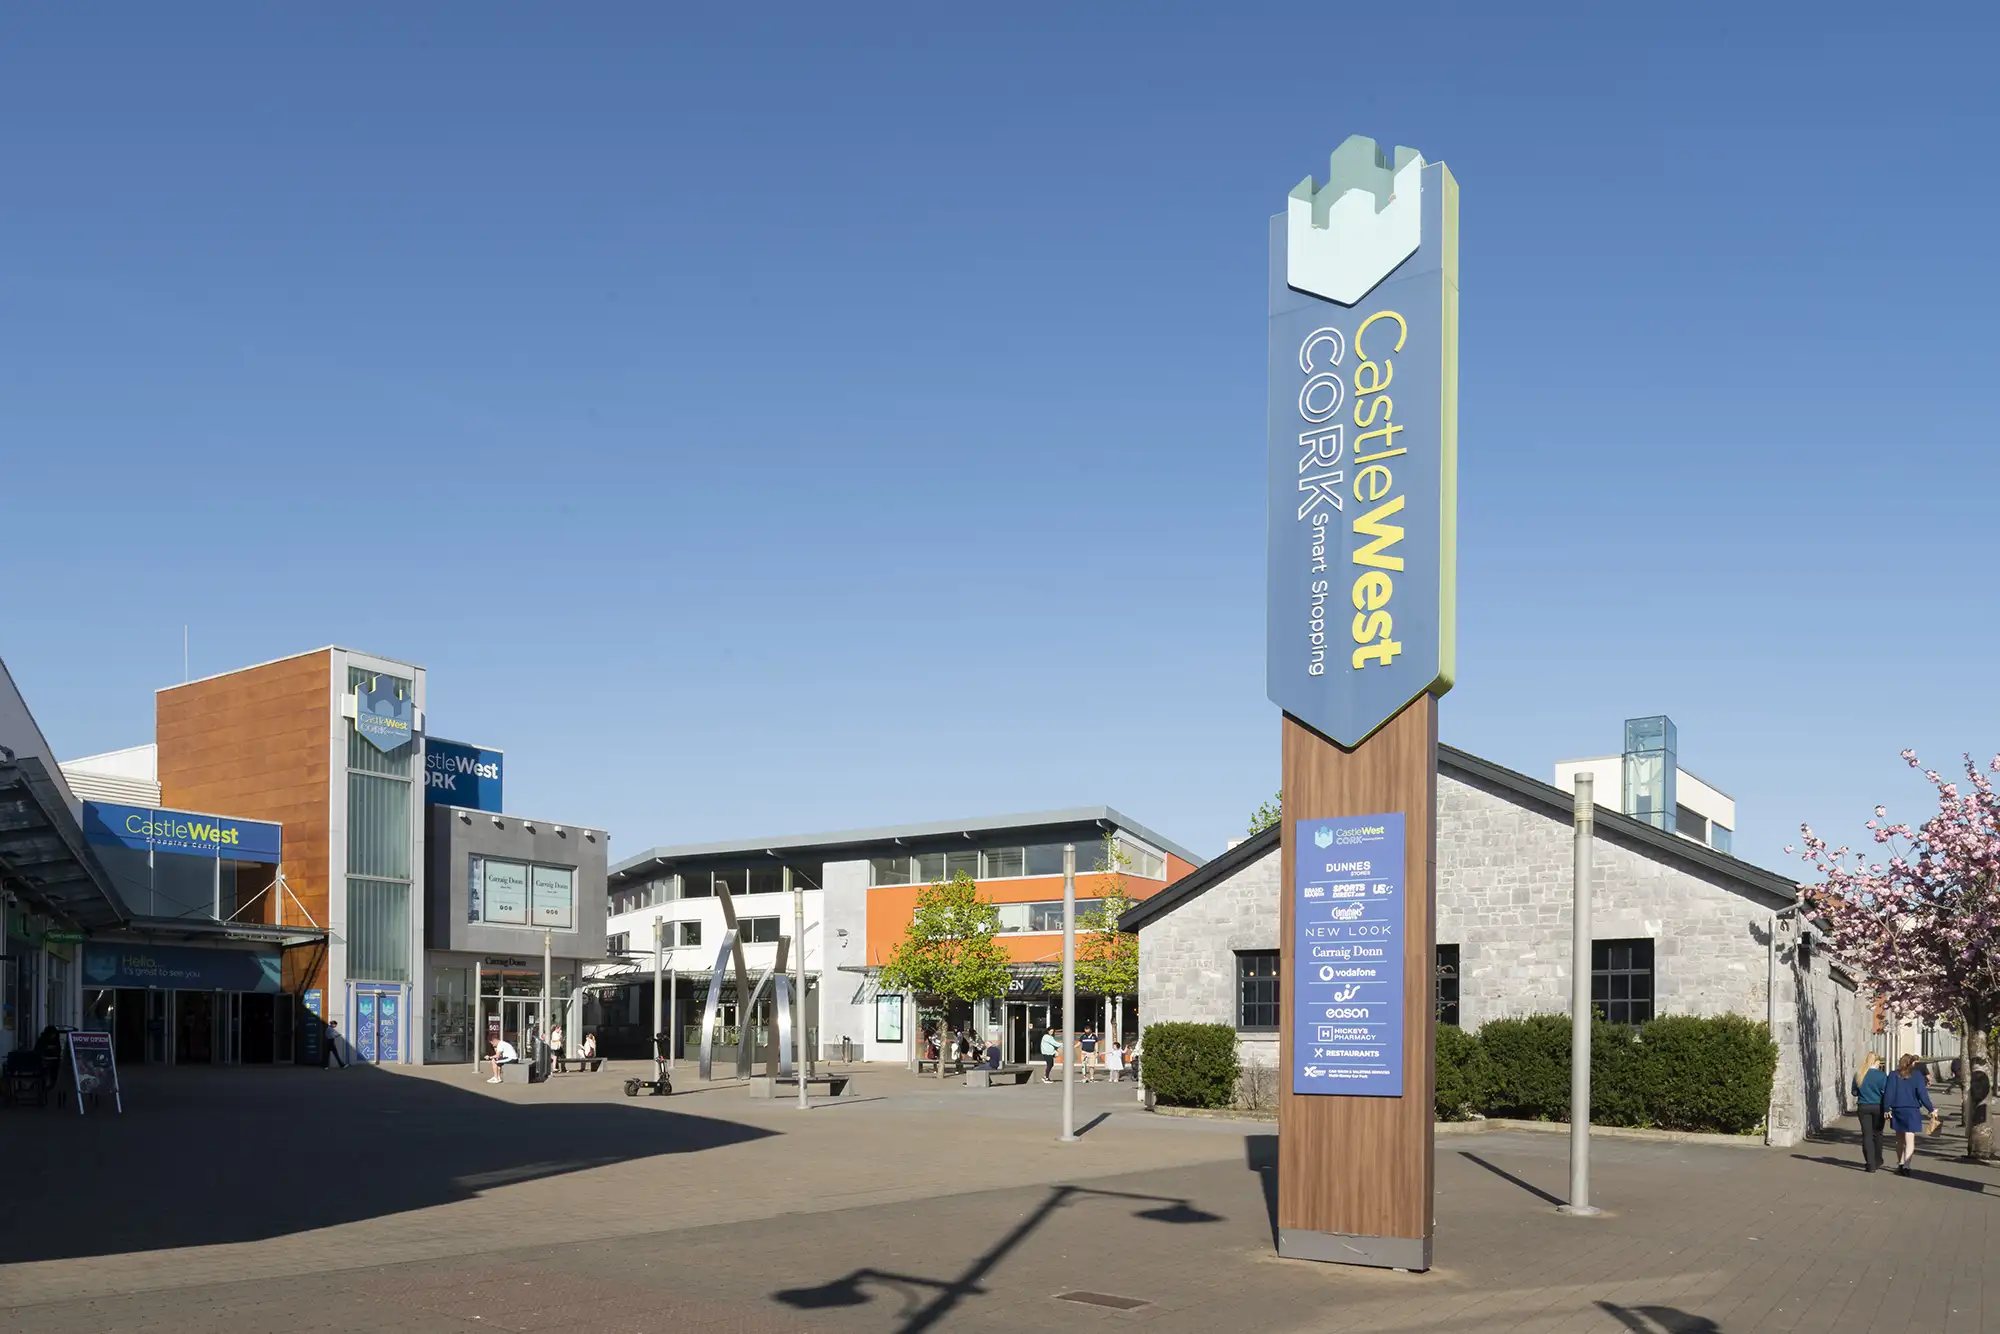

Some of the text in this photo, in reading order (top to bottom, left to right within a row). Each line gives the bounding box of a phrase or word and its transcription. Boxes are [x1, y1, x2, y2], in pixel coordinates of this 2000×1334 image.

[1298, 326, 1346, 521] CORK
[1352, 310, 1408, 670] CastleWest
[1308, 512, 1329, 677] Smart Shopping
[425, 752, 499, 780] stleWest
[125, 814, 239, 845] CastleWest
[1336, 826, 1385, 837] CastleWest
[1336, 836, 1363, 845] CORK
[1326, 861, 1371, 872] DUNNES
[488, 874, 524, 885] Carraig Donn
[535, 880, 569, 890] Carraig Donn
[1333, 884, 1366, 892] SPORTS
[1305, 925, 1392, 937] NEW LOOK
[1313, 945, 1383, 960] Carraig Donn
[485, 957, 527, 967] Carraig Donn
[159, 968, 168, 977] to
[169, 970, 184, 978] see
[1335, 968, 1376, 977] vodafone
[1326, 1008, 1369, 1019] eason
[72, 1035, 90, 1043] NOW
